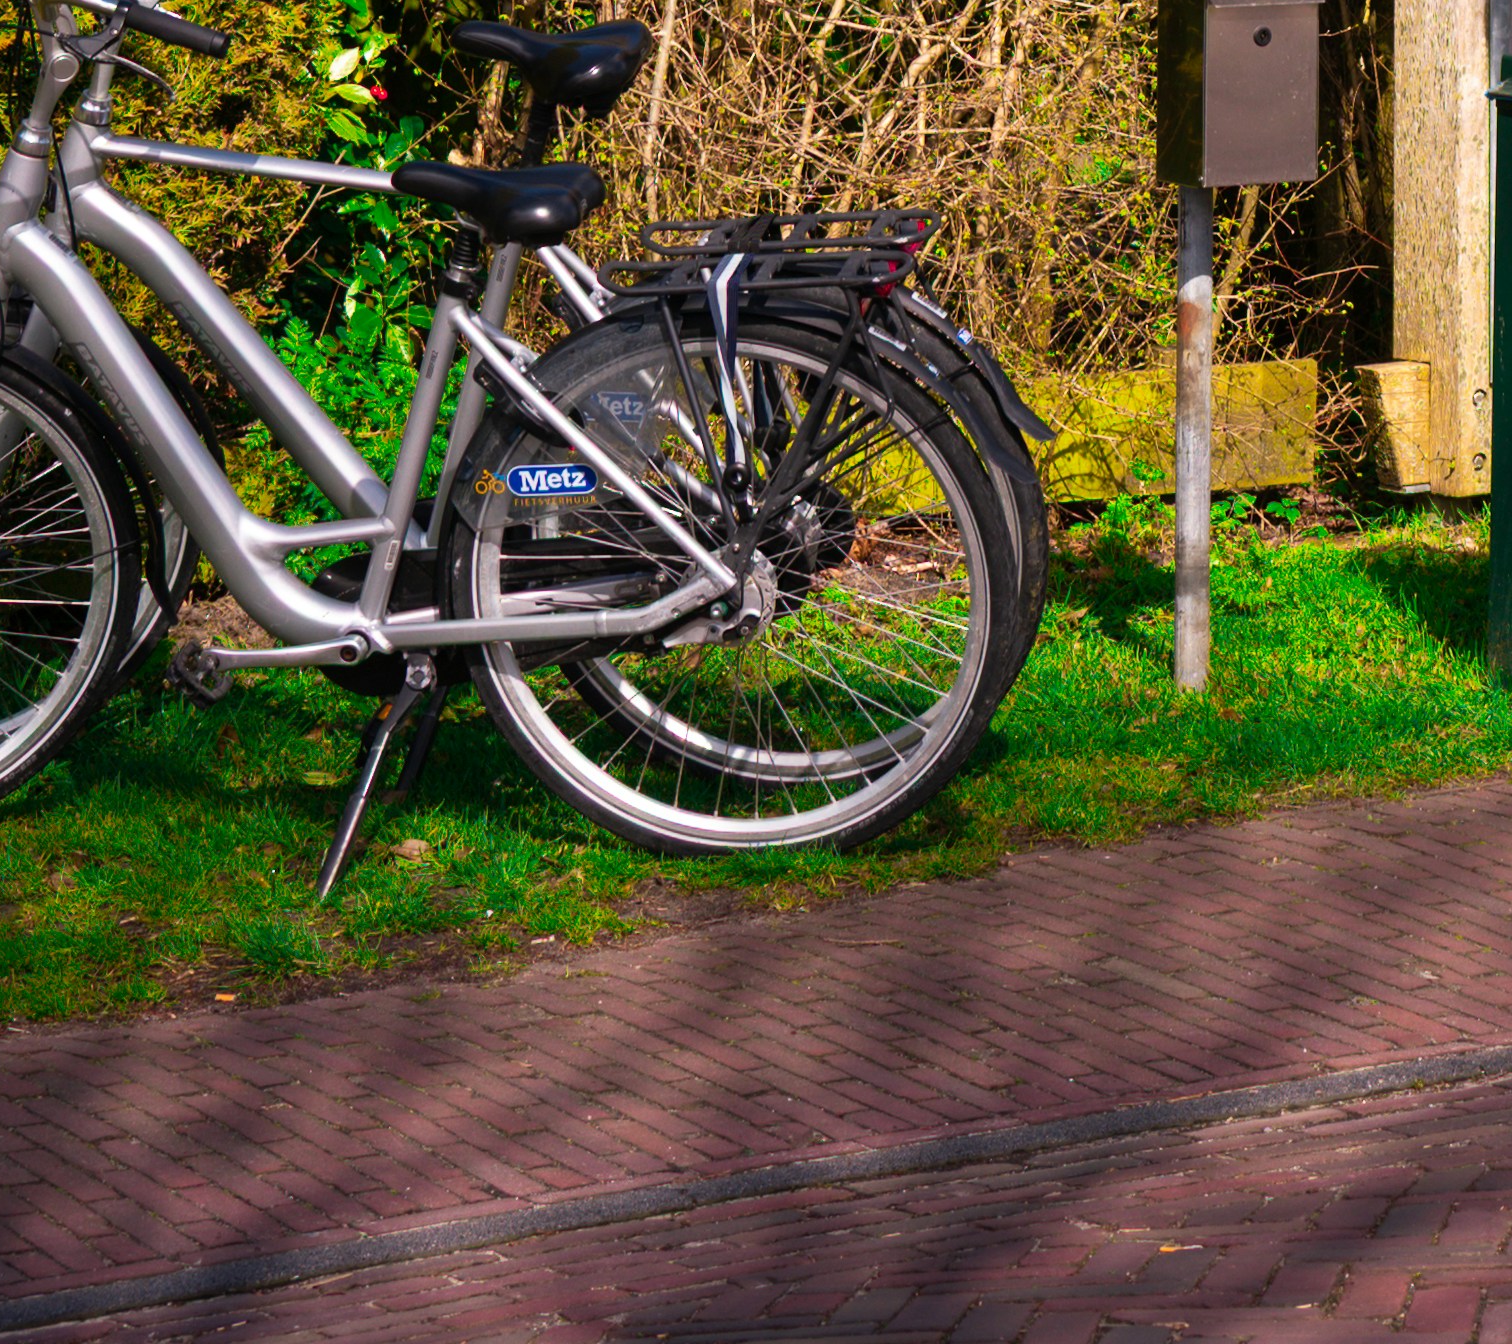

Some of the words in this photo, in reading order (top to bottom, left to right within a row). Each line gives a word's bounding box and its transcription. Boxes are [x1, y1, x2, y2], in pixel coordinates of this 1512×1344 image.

[74, 342, 150, 448] BATAVUS
[518, 468, 586, 492] Metz
[514, 496, 597, 507] FIETSVERHUUR
